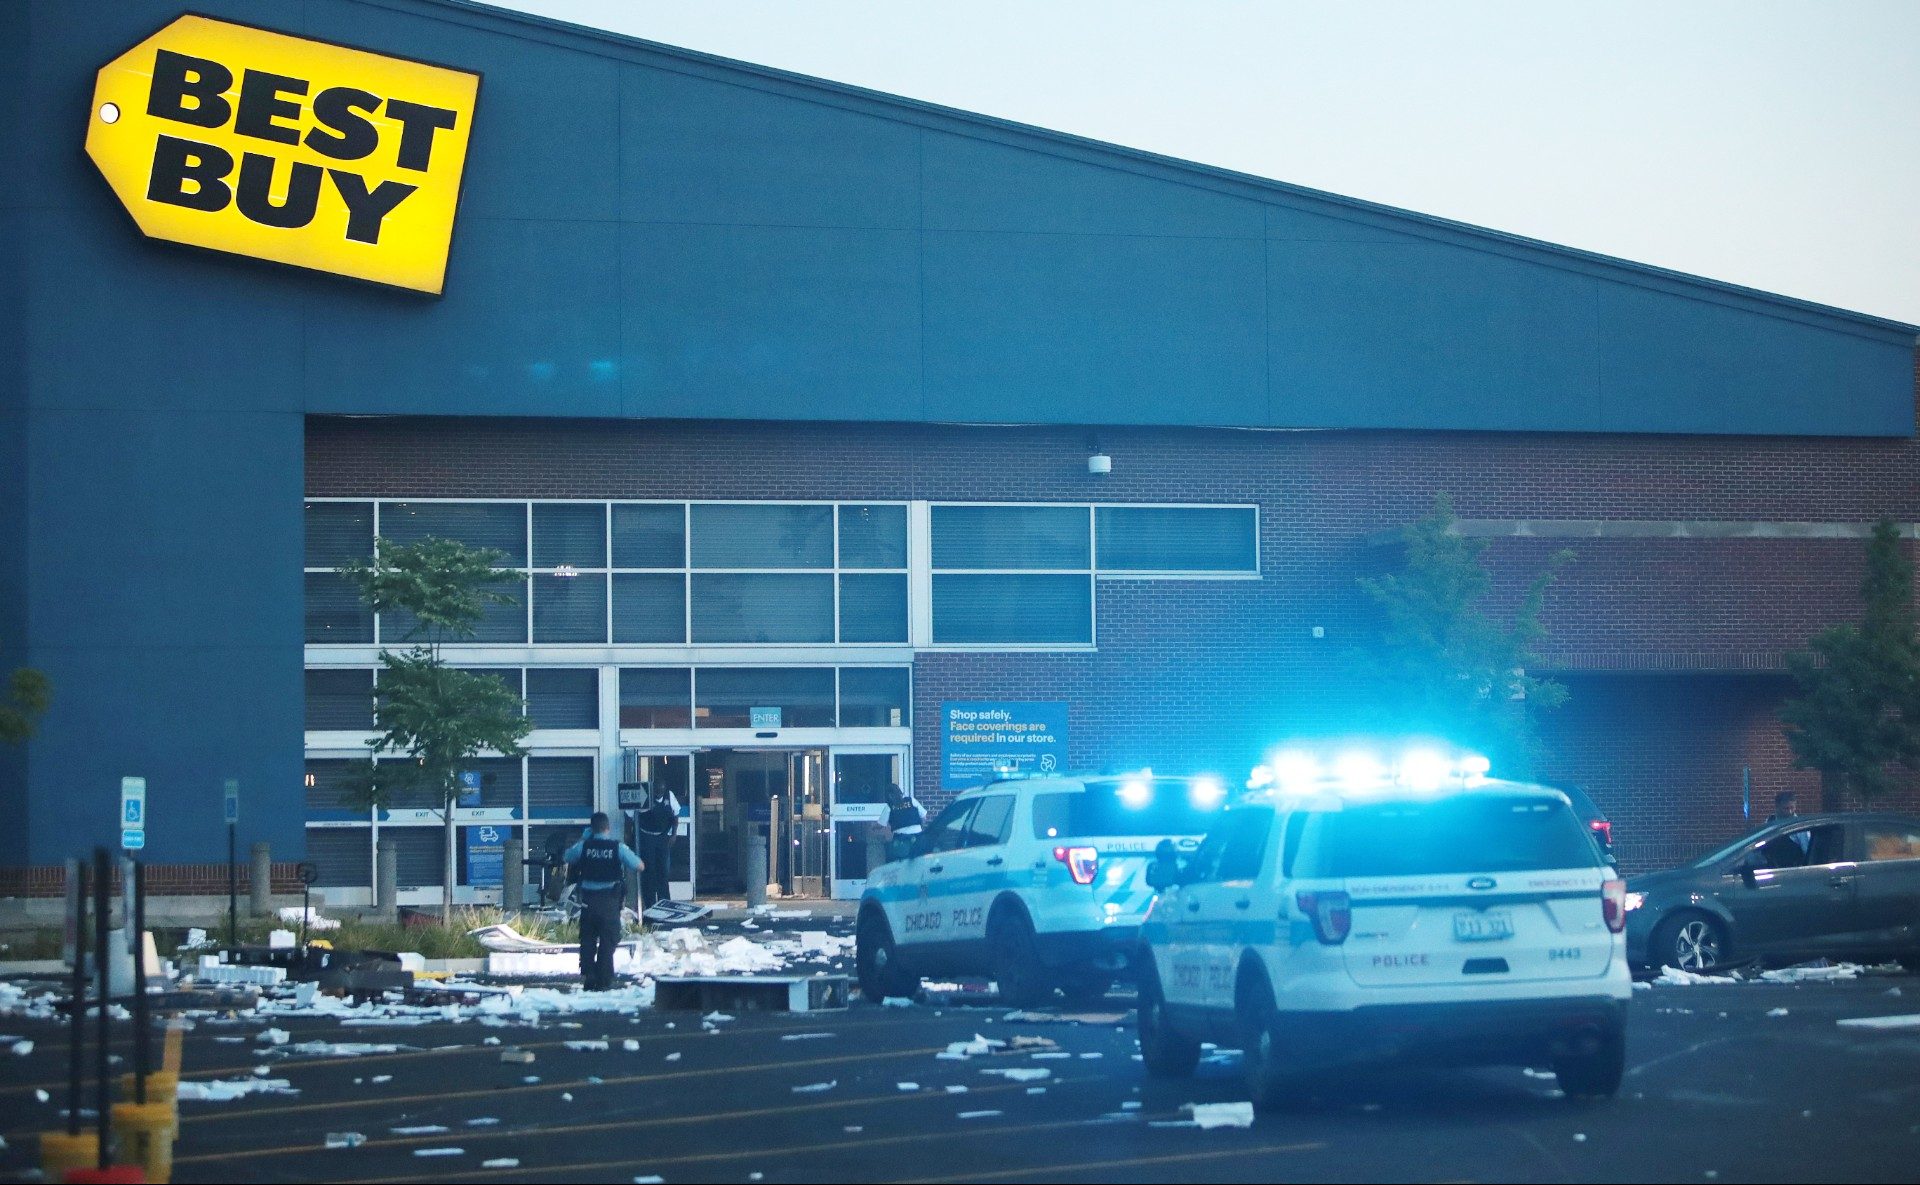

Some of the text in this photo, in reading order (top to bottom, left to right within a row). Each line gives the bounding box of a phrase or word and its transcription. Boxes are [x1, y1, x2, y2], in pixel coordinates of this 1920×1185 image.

[146, 48, 458, 173] BEST
[146, 133, 419, 245] BUY
[753, 713, 779, 722] ENTER
[950, 709, 1012, 721] Shop safely.
[950, 721, 1046, 733] Face coverings are
[950, 733, 994, 744] required
[996, 733, 1006, 742] in
[1027, 733, 1056, 743] store.
[1107, 842, 1145, 851] POLICE
[586, 848, 613, 859] POLICE
[905, 907, 982, 933] CHICAGO POLICE
[1372, 953, 1429, 966] POLICE
